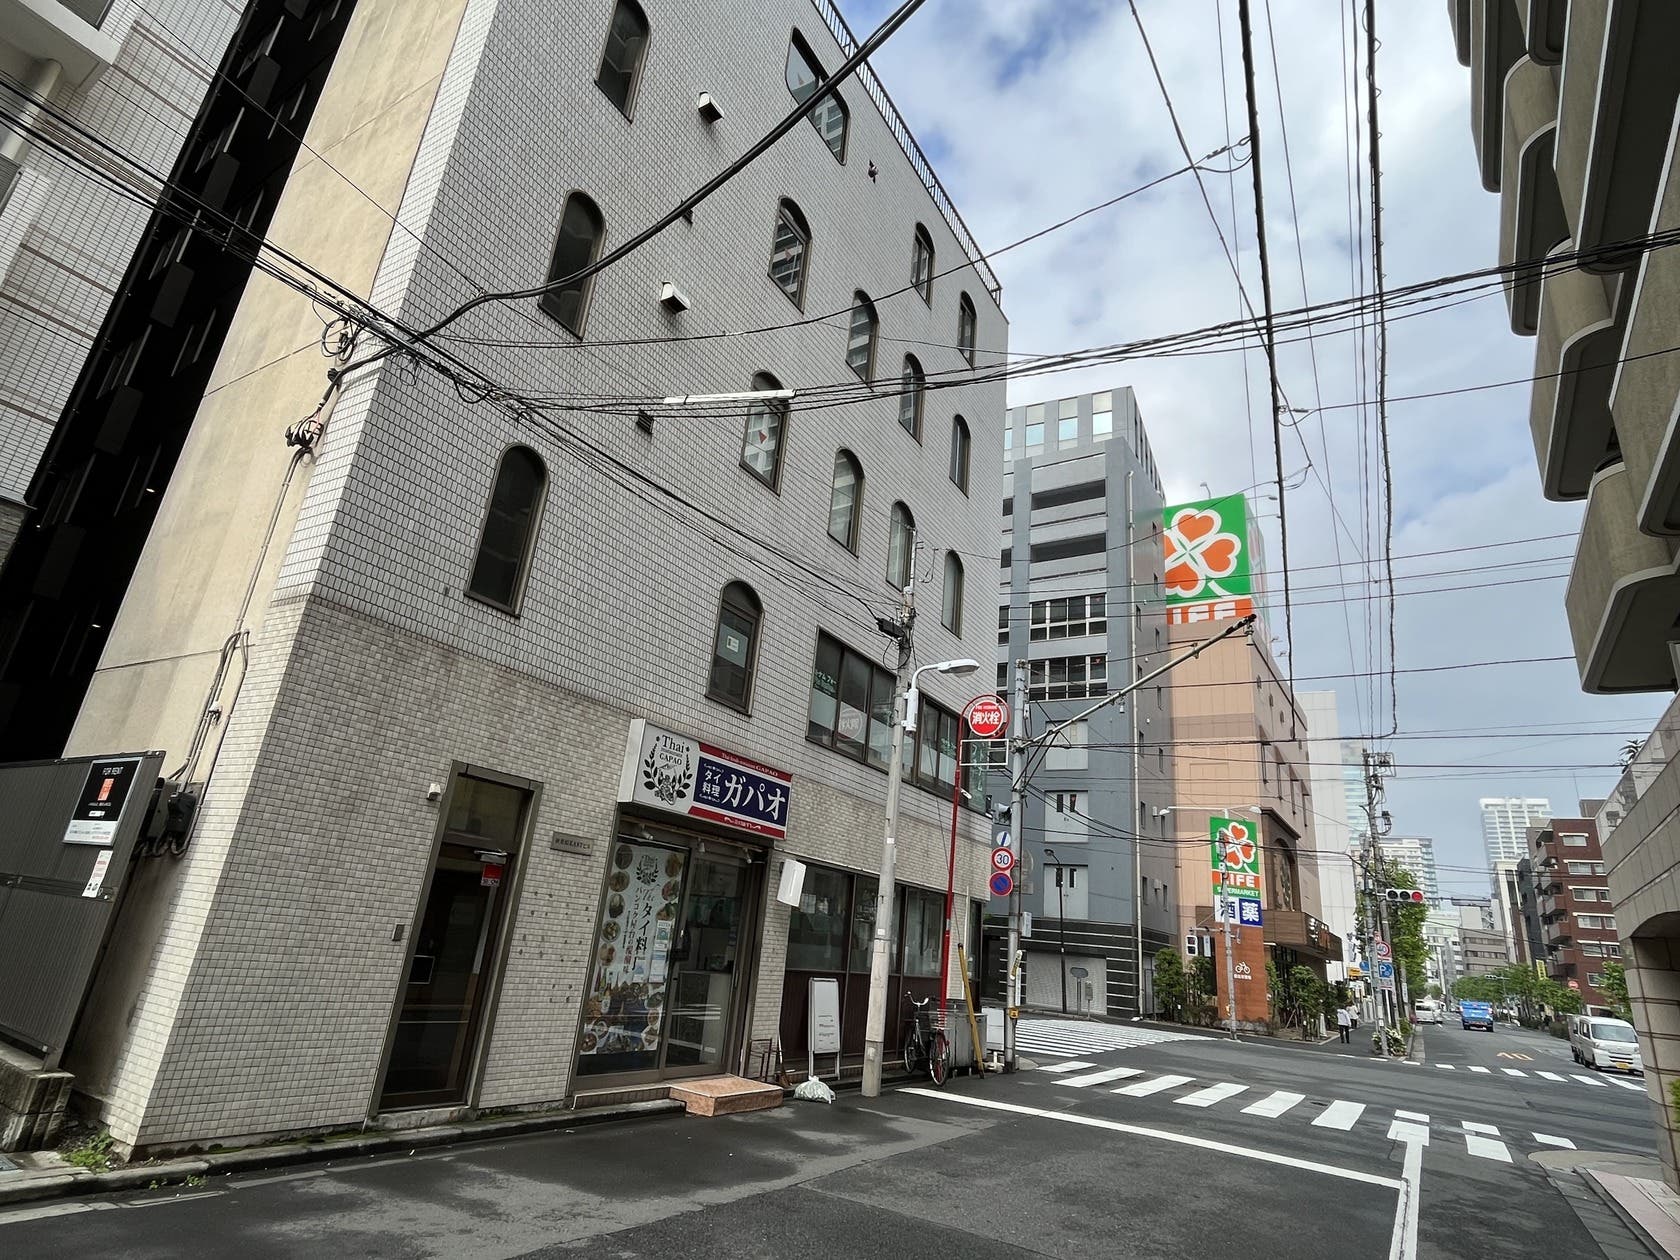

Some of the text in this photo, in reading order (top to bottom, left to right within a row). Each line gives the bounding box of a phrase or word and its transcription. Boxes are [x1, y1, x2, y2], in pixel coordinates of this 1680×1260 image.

[972, 711, 1000, 725] 消火栓
[662, 734, 684, 753] Thai
[660, 752, 682, 766] GAPAO
[705, 769, 721, 784] タイ
[755, 764, 778, 777] GAPAO
[702, 781, 721, 797] 料理
[721, 774, 786, 820] ガパオ
[996, 854, 1010, 865] 30
[1216, 886, 1259, 897] SERMARKET
[1241, 902, 1260, 922] 薬
